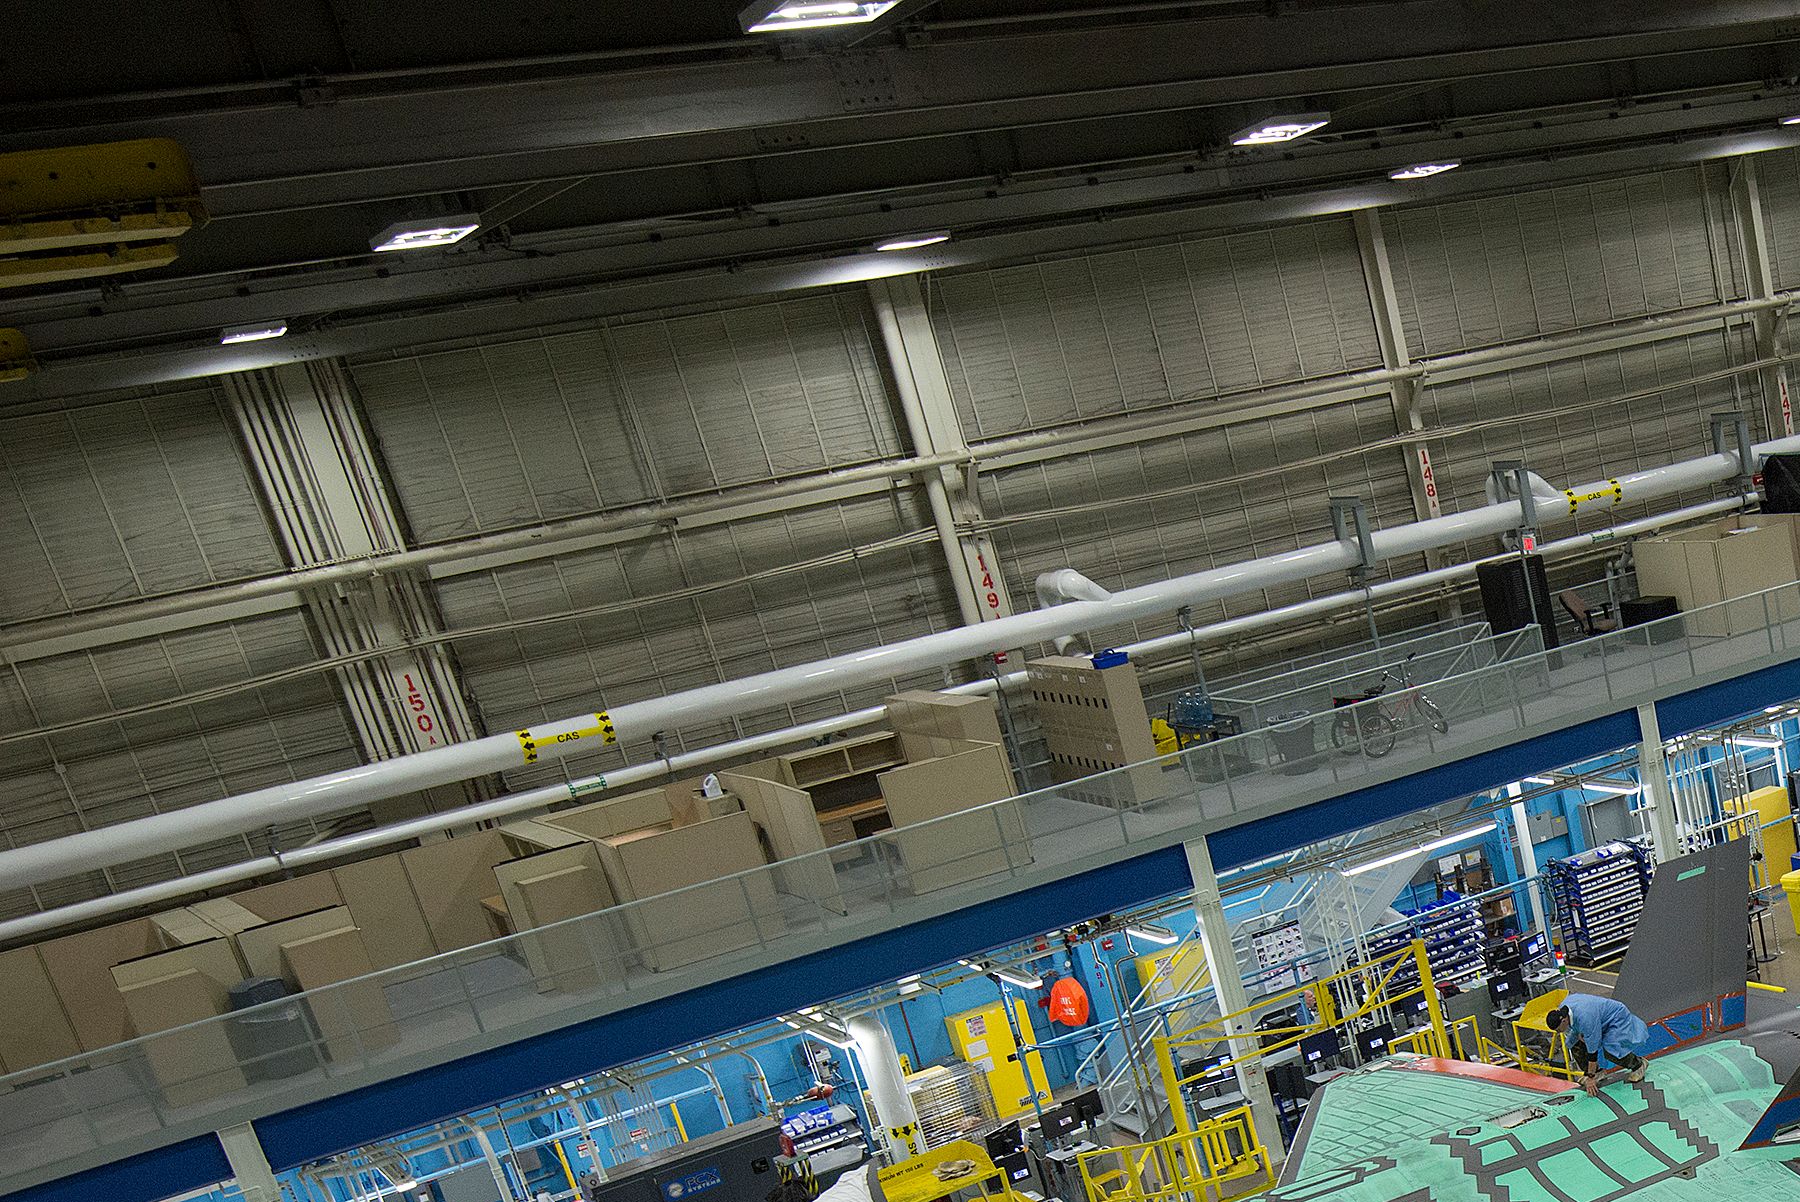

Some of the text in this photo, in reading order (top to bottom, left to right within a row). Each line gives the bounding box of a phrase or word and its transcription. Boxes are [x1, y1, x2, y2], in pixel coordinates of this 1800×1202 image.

[1780, 383, 1790, 425] 147
[1421, 450, 1436, 497] 148
[1587, 492, 1602, 502] CAS
[977, 555, 999, 609] 149
[404, 674, 433, 733] 150
[557, 731, 580, 744] CAS
[907, 1142, 917, 1158] AS
[914, 1162, 924, 1172] LBS
